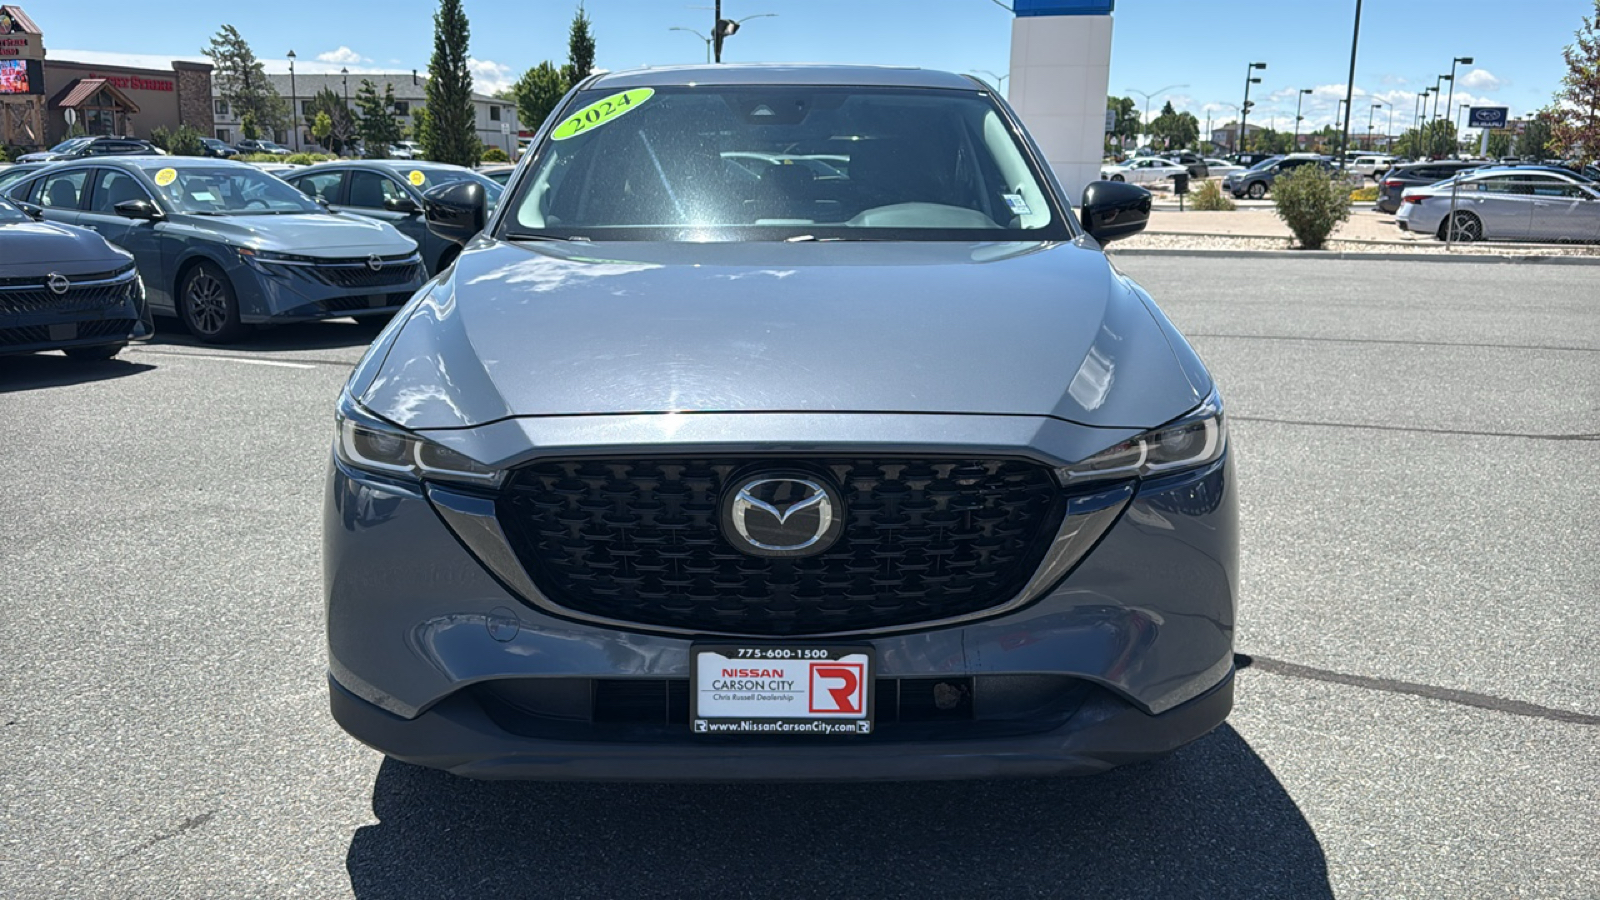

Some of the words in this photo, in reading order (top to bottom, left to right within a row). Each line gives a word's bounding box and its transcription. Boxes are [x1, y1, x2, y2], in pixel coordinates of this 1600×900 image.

[131, 76, 173, 91] STRIKE
[568, 93, 632, 134] 2024
[737, 648, 829, 659] 775-600-1500
[721, 668, 784, 678] NISSAN
[712, 679, 765, 691] CARSON
[768, 680, 794, 691] CITY
[713, 693, 731, 701] Chris
[732, 693, 755, 701] Russell
[756, 694, 794, 702] Dealership
[709, 720, 856, 734] www.NissanCarsonCity.com
